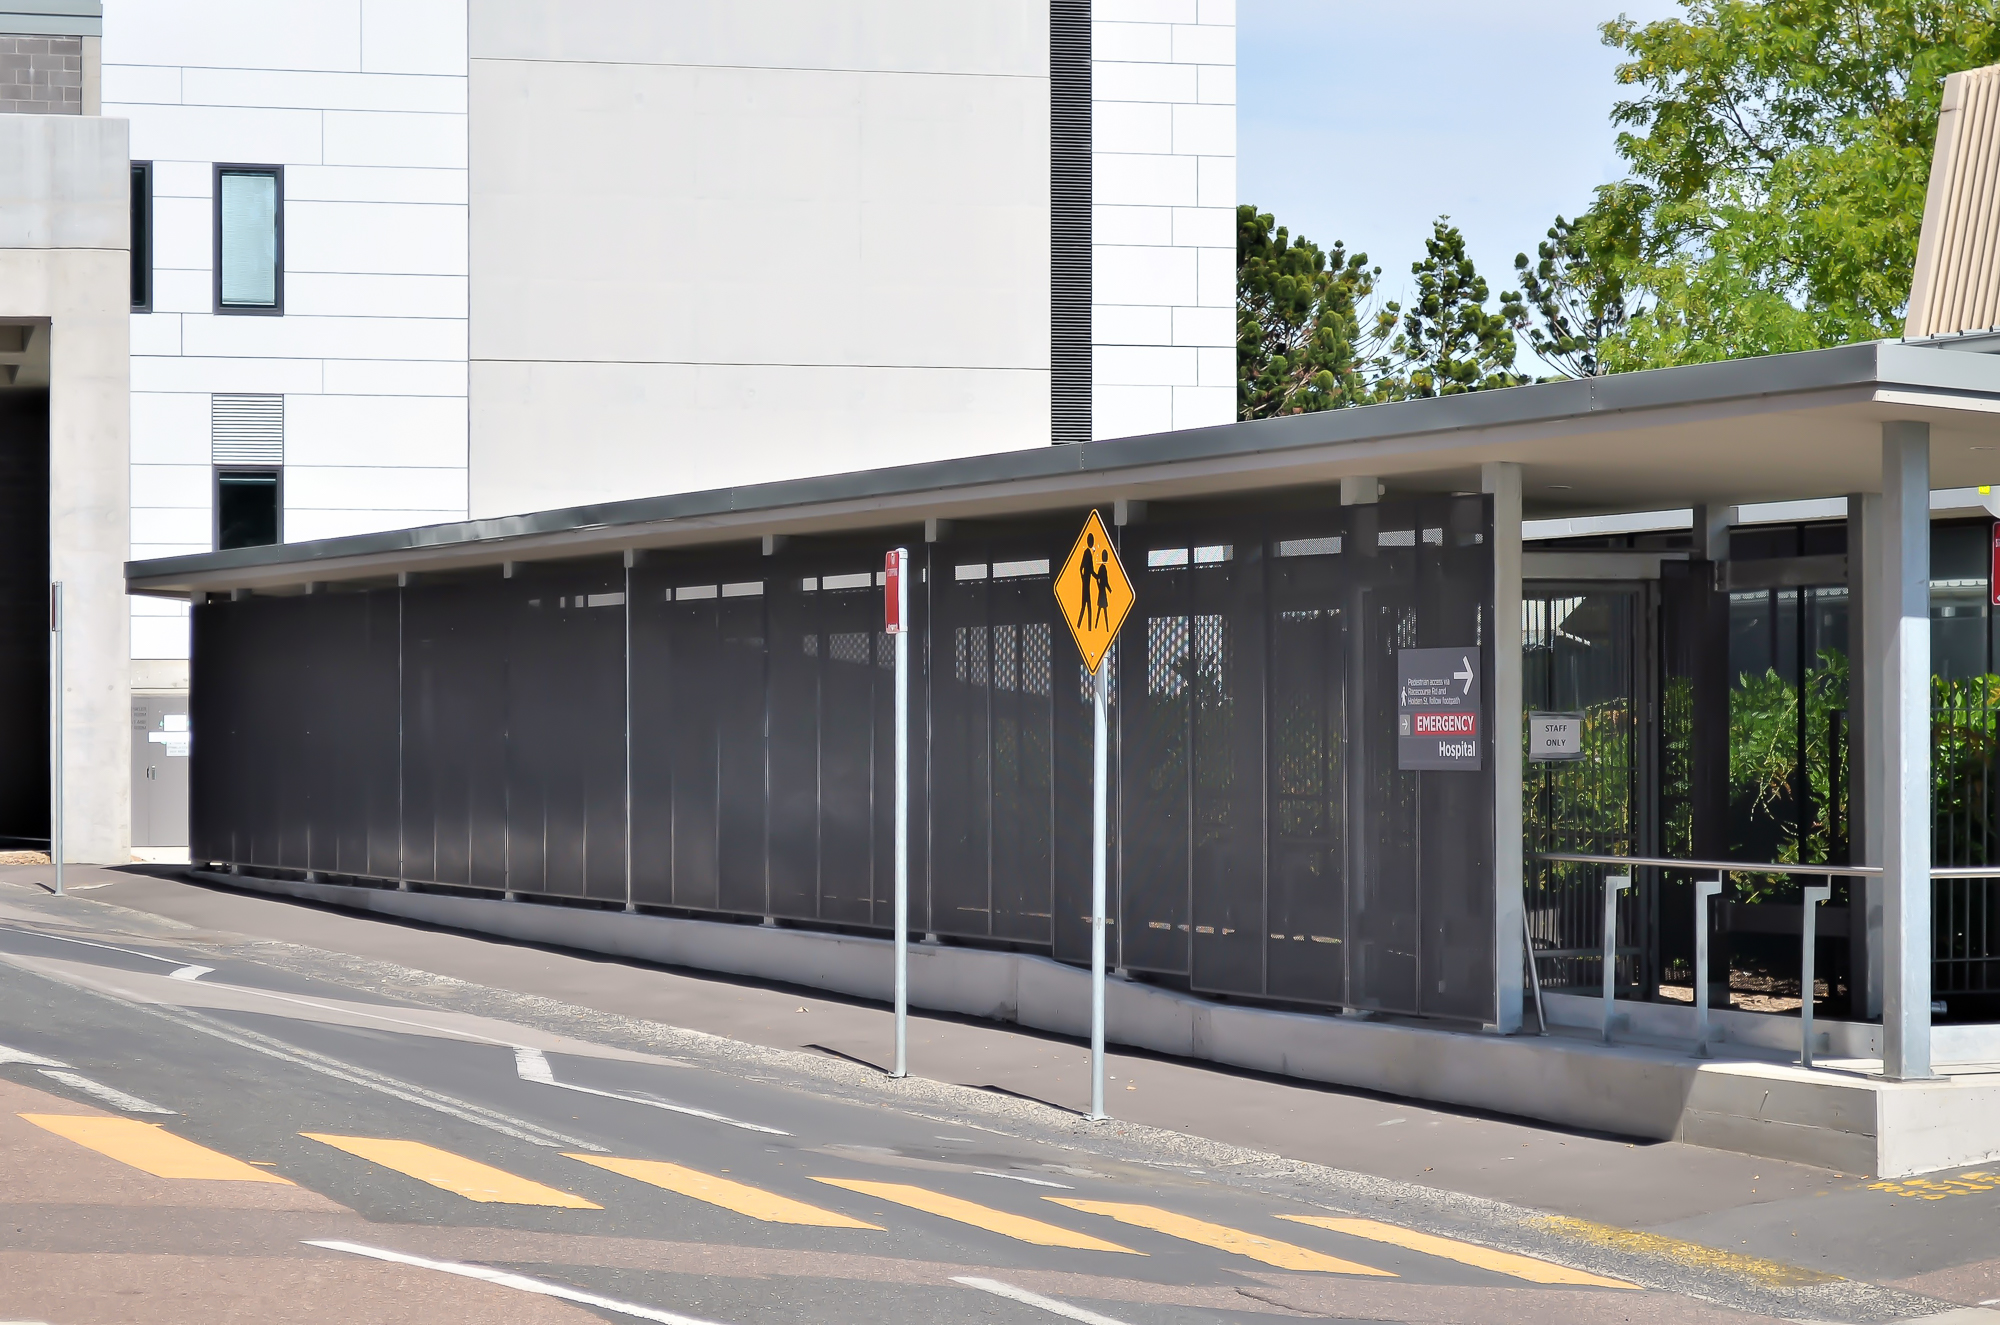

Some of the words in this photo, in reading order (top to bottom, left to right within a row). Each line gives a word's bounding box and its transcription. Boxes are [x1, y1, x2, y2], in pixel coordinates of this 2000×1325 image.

[1408, 678, 1429, 686] Pedestrian
[1417, 715, 1474, 731] EMERGENCY
[1545, 724, 1567, 732] STAFF
[1546, 739, 1566, 747] ONLY
[1439, 740, 1476, 760] Hospital
